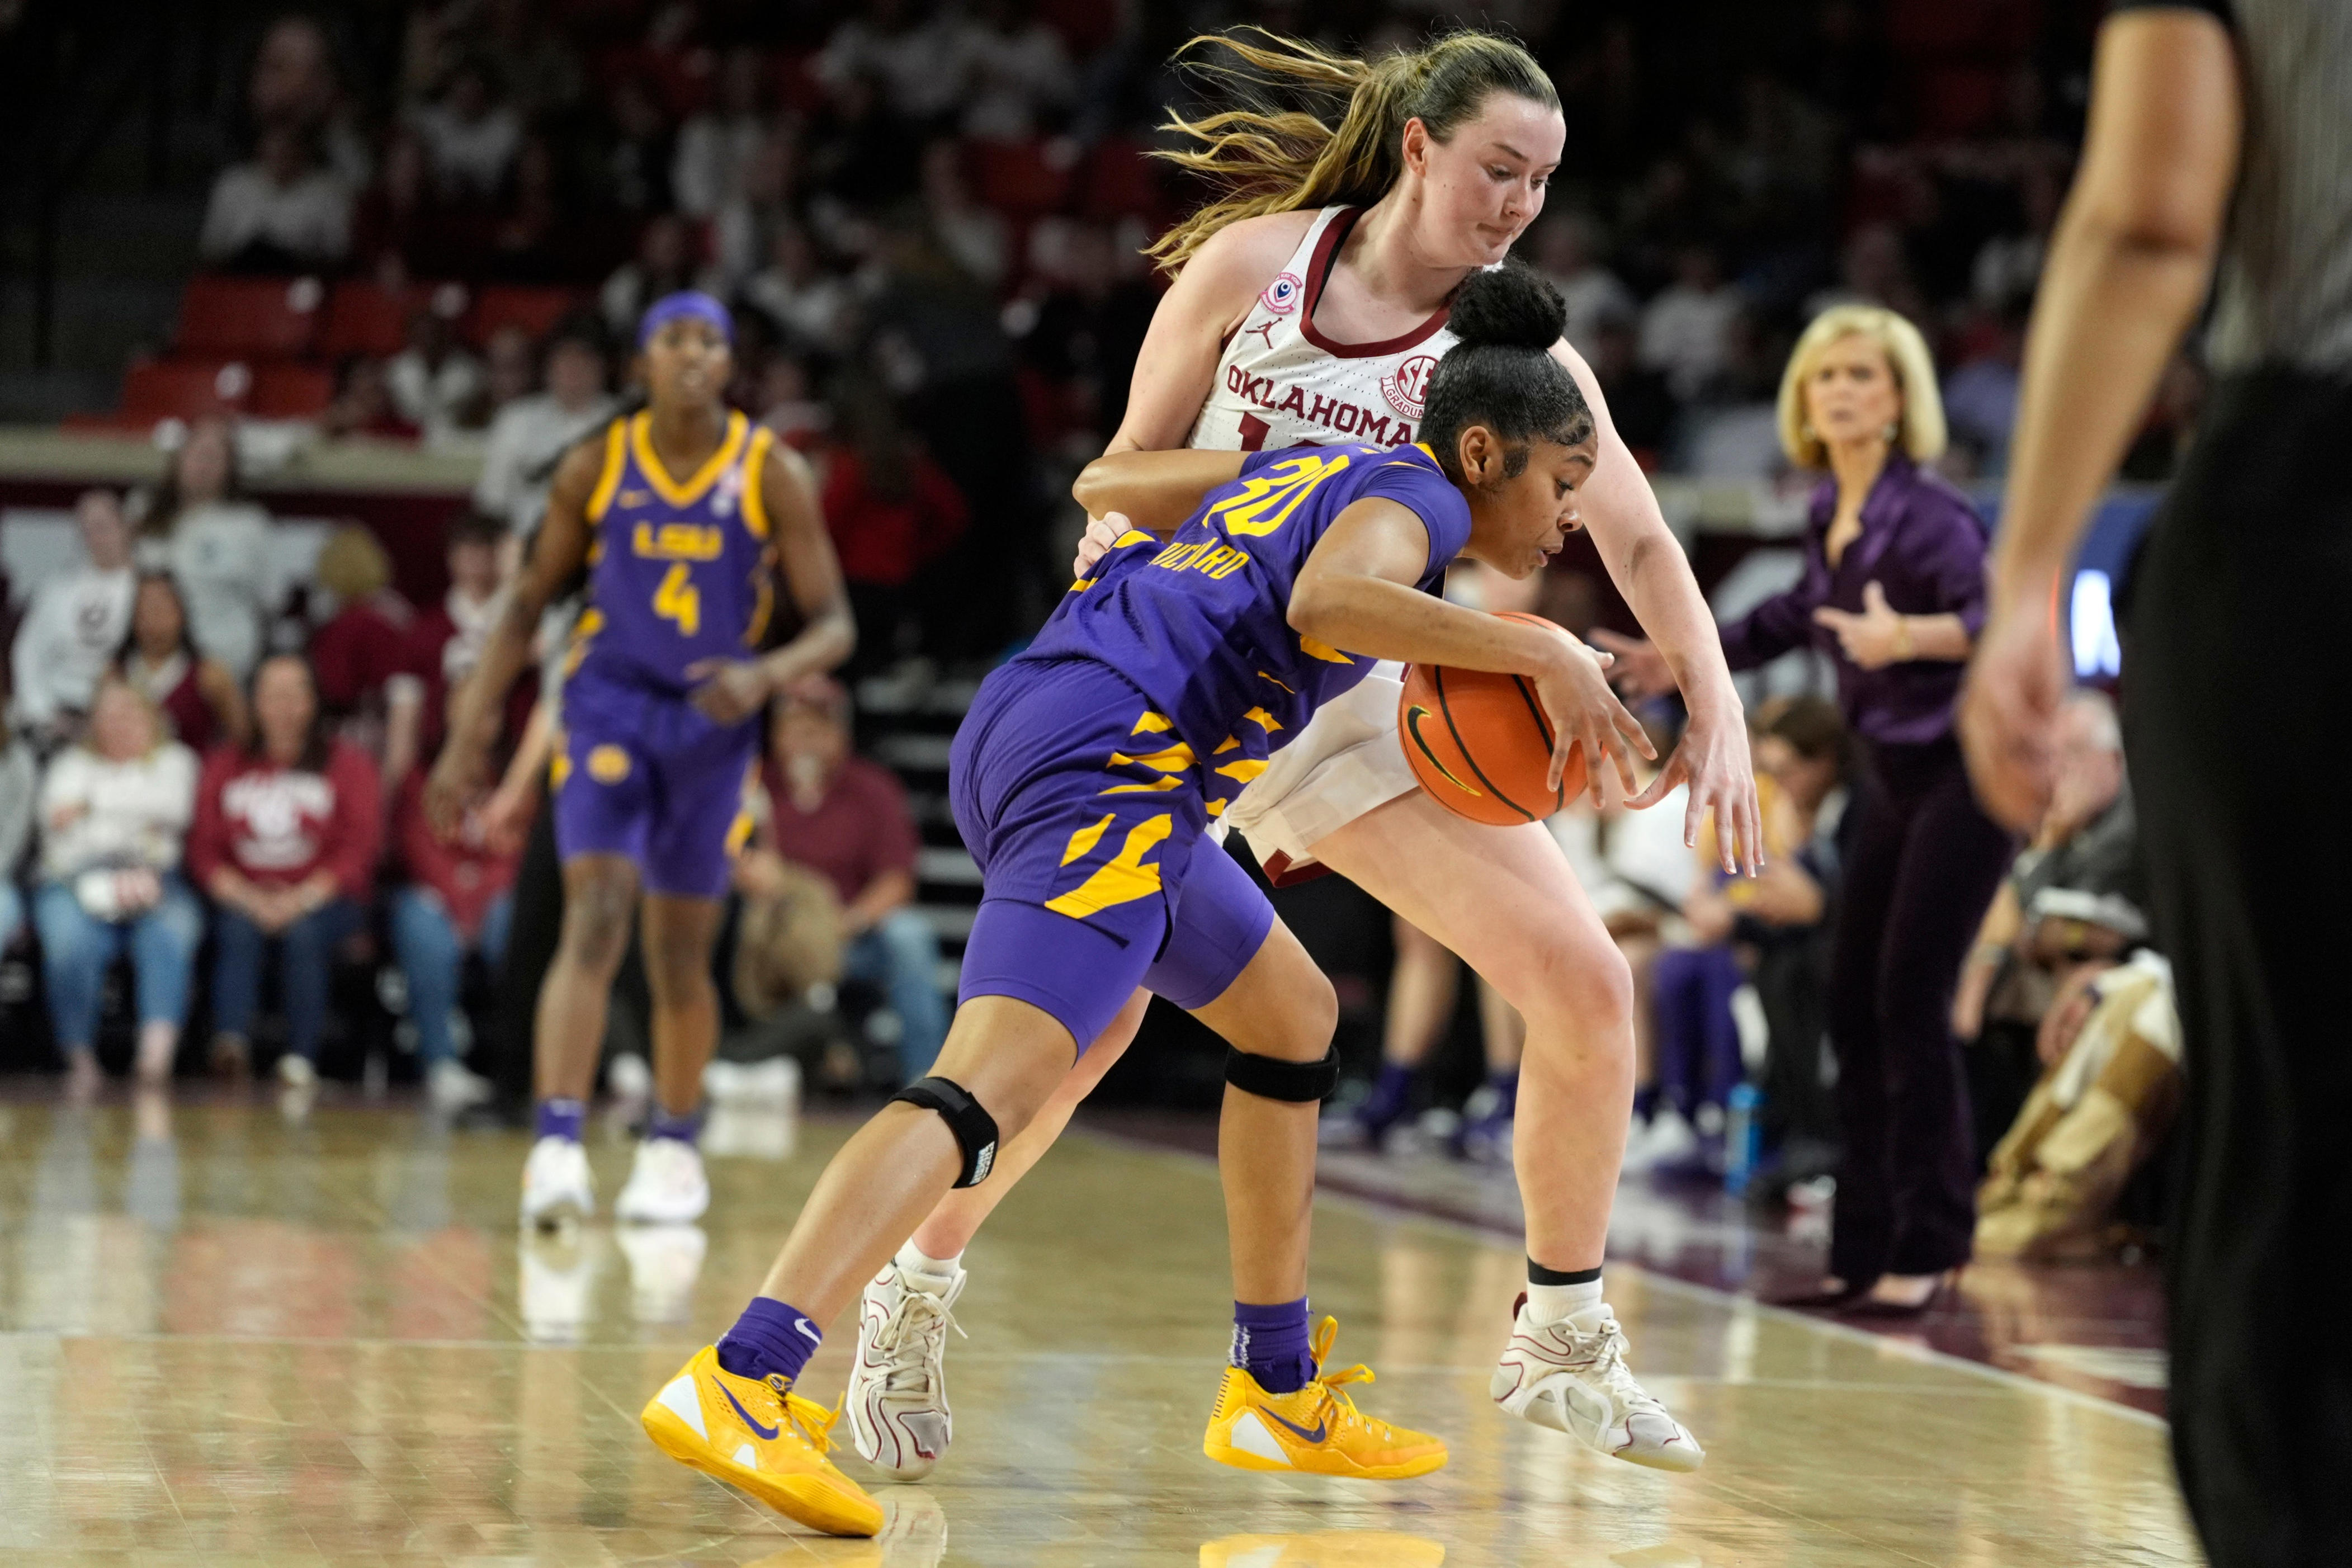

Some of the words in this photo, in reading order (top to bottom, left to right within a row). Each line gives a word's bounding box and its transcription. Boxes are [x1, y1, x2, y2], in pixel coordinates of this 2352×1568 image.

[1399, 357, 1435, 402] SE
[1227, 365, 1411, 447] OKLAHOMA
[1386, 389, 1424, 417] GRADUA
[633, 521, 724, 560] LSU
[653, 561, 700, 636] 4
